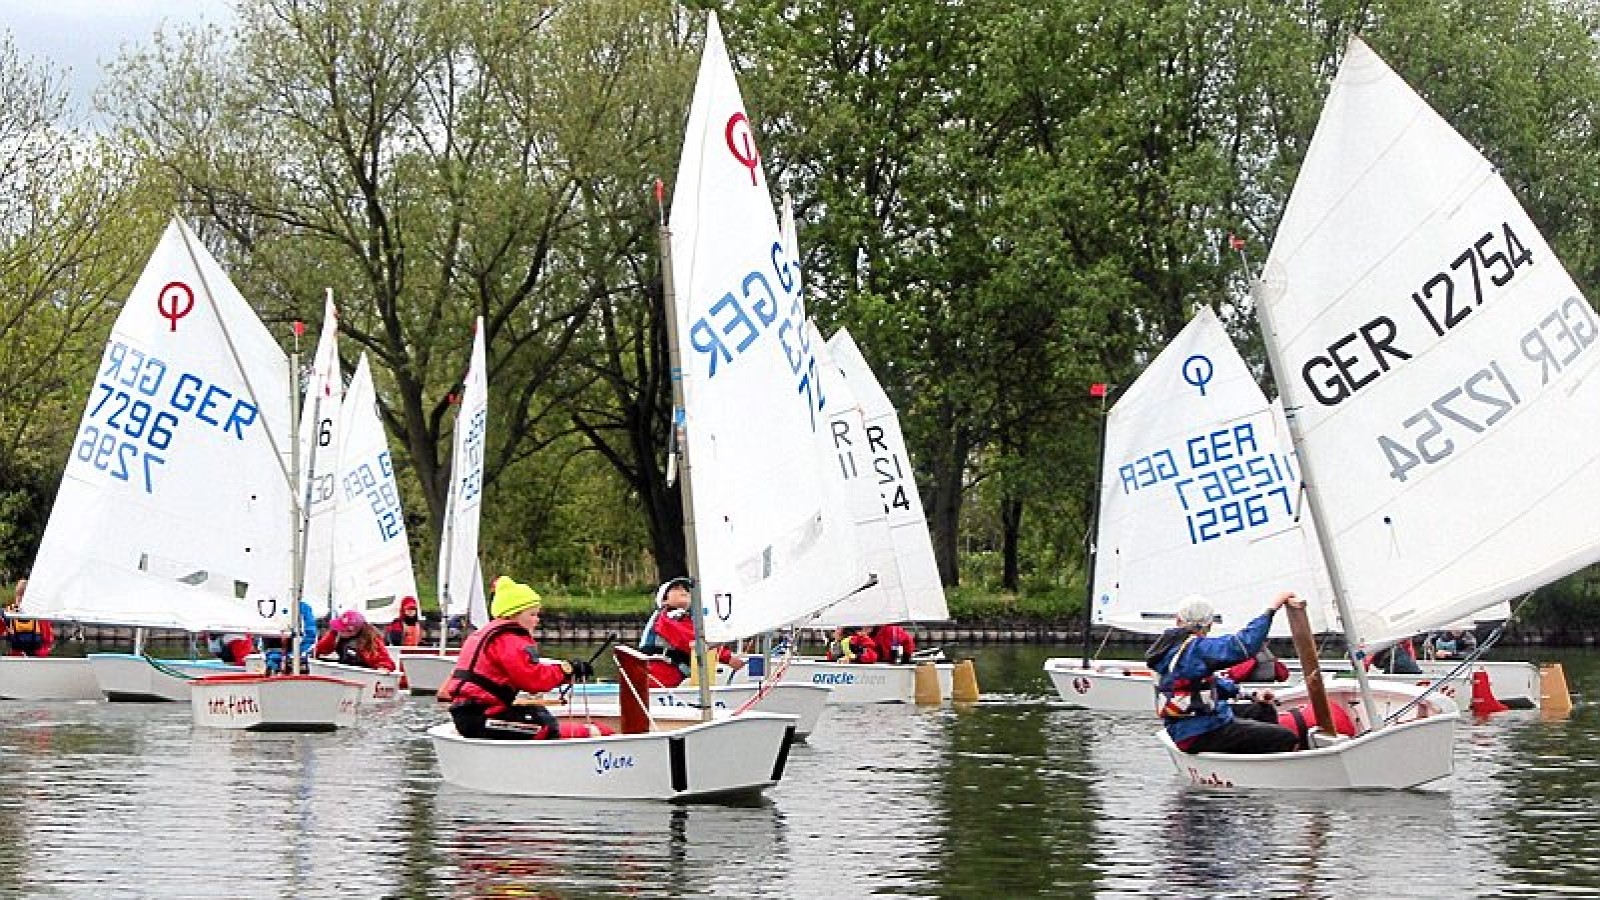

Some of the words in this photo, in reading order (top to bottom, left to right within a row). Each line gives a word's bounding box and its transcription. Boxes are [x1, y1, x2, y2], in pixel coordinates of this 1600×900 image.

[1302, 316, 1413, 406] GER
[1412, 222, 1533, 337] 12754
[90, 383, 179, 451] 7296
[170, 373, 259, 441] GER
[1186, 422, 1258, 469] GER
[1186, 486, 1293, 545] 12967
